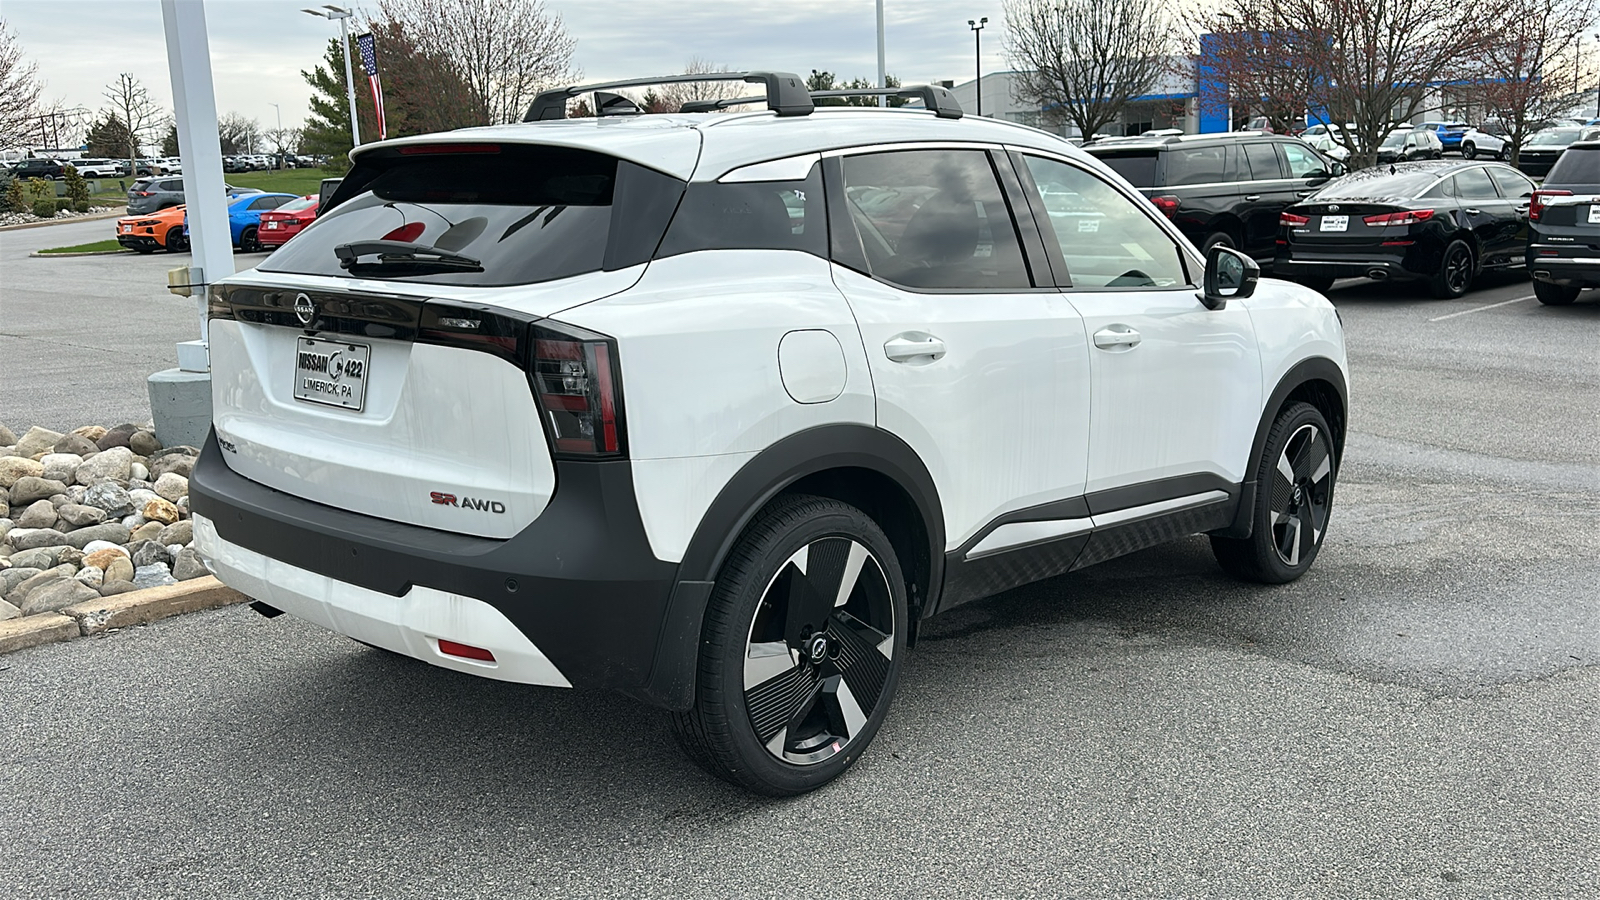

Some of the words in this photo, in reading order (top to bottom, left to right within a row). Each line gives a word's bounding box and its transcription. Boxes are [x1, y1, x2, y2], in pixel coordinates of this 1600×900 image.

[298, 353, 328, 373] NISSAN
[344, 360, 363, 378] 422
[303, 379, 339, 396] LIMERICK,
[341, 385, 352, 398] PA
[430, 491, 459, 508] SR
[461, 496, 506, 514] AWD
